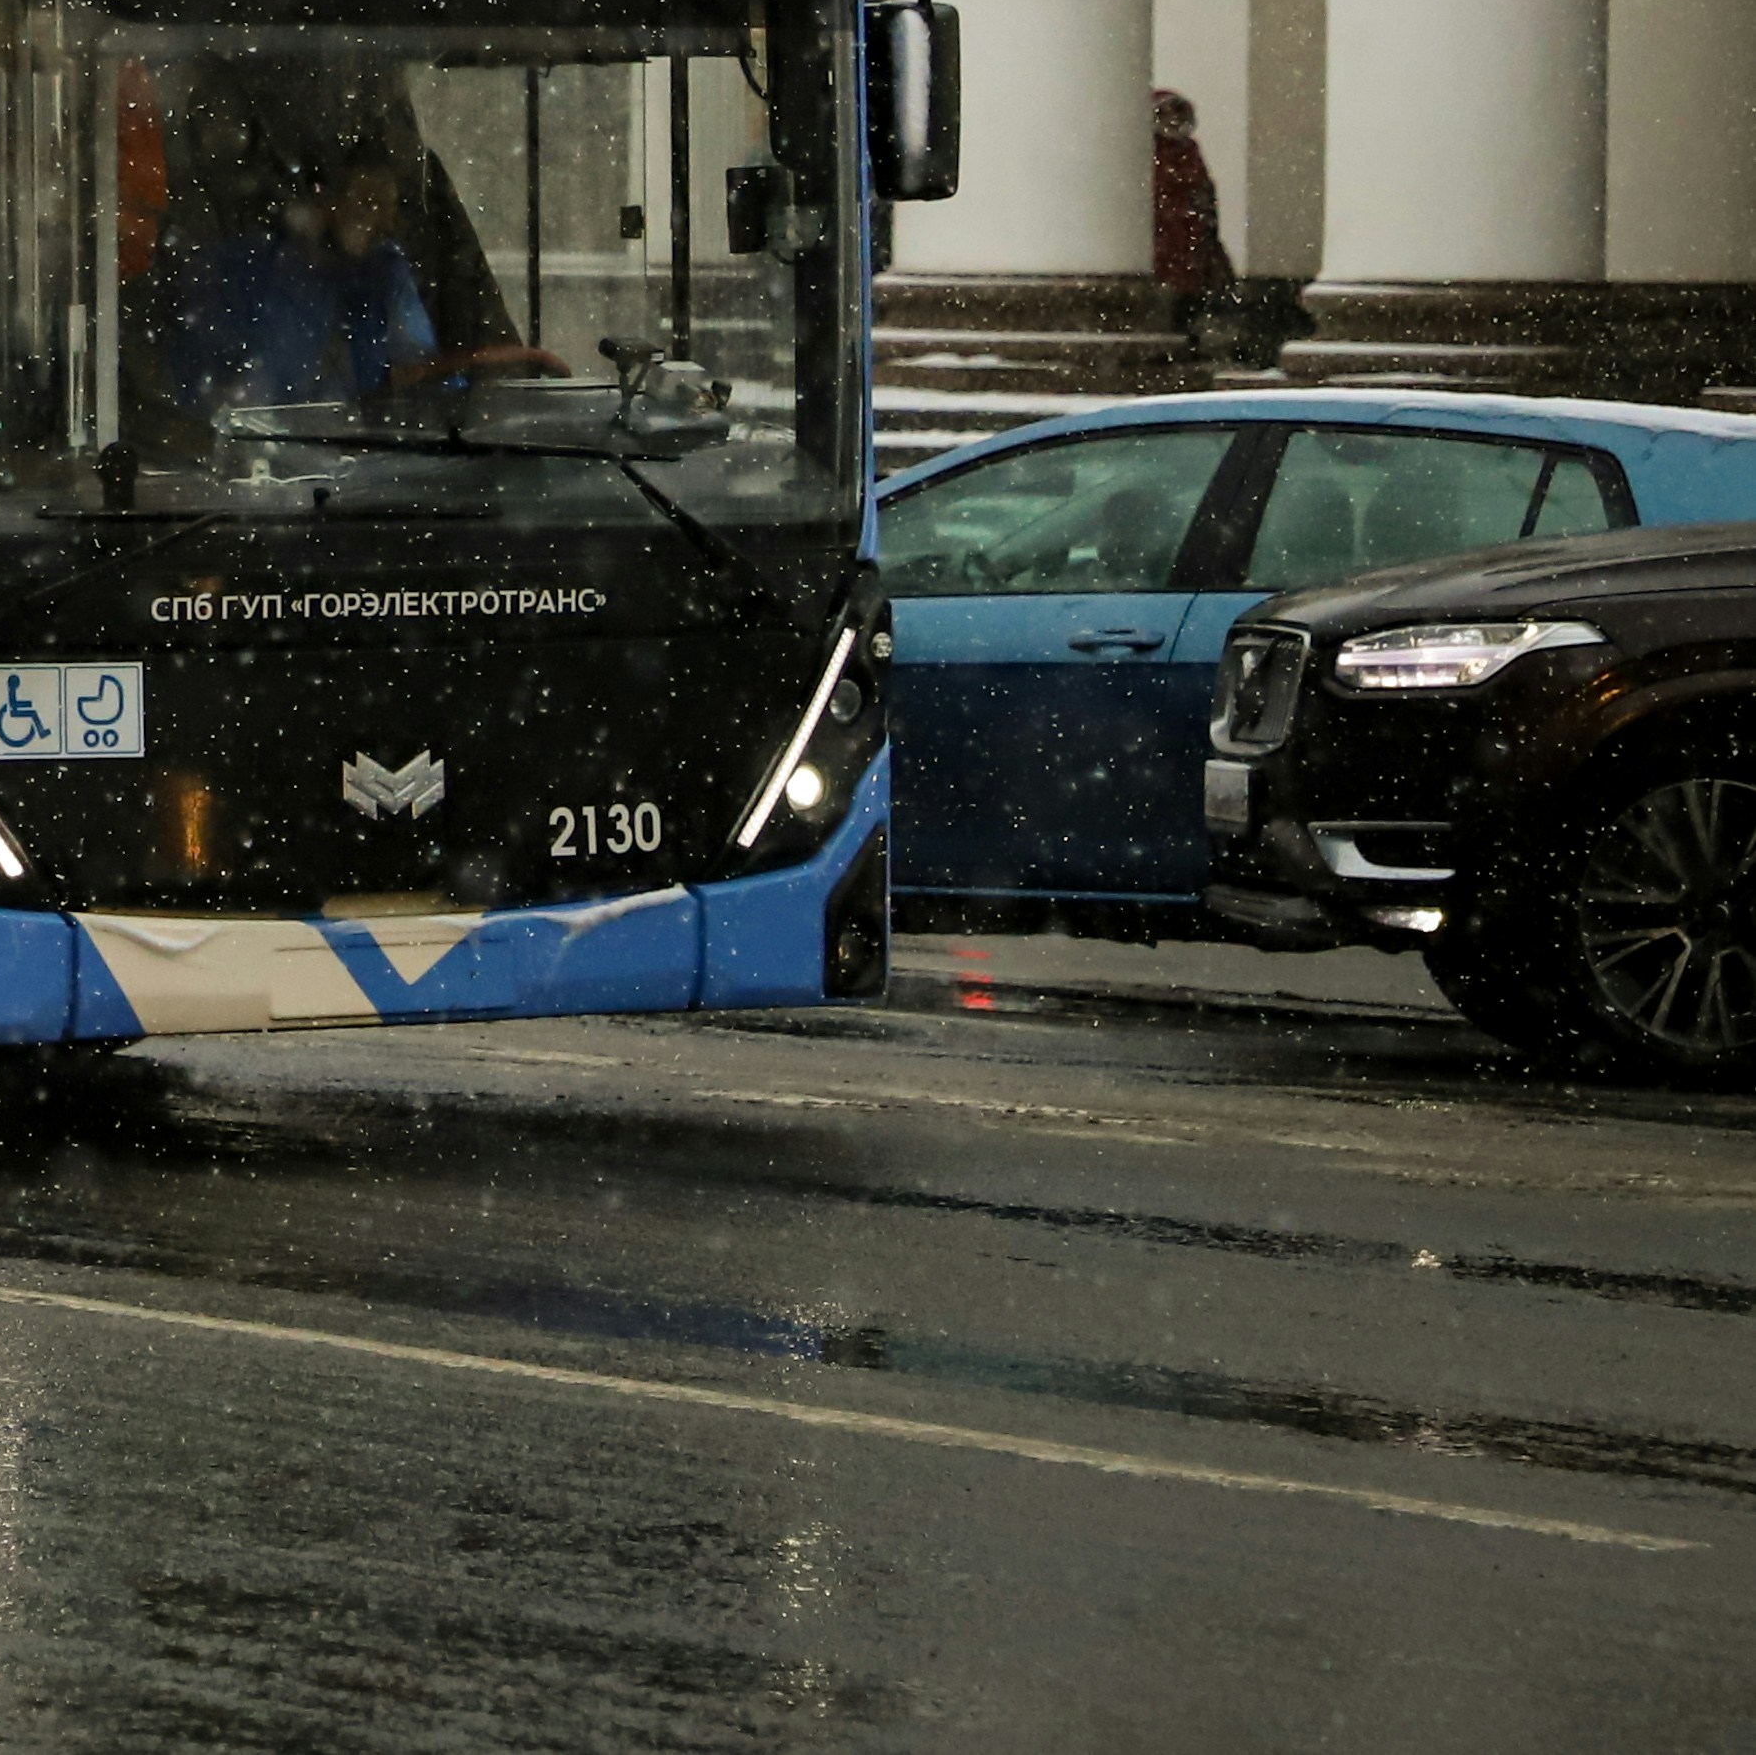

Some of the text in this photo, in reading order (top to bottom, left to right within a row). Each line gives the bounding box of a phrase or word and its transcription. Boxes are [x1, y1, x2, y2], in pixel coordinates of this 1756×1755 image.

[150, 588, 607, 622] СПб ГУП «ГОРЭЛЕКТРОТРАНС»
[549, 802, 661, 856] 2130
